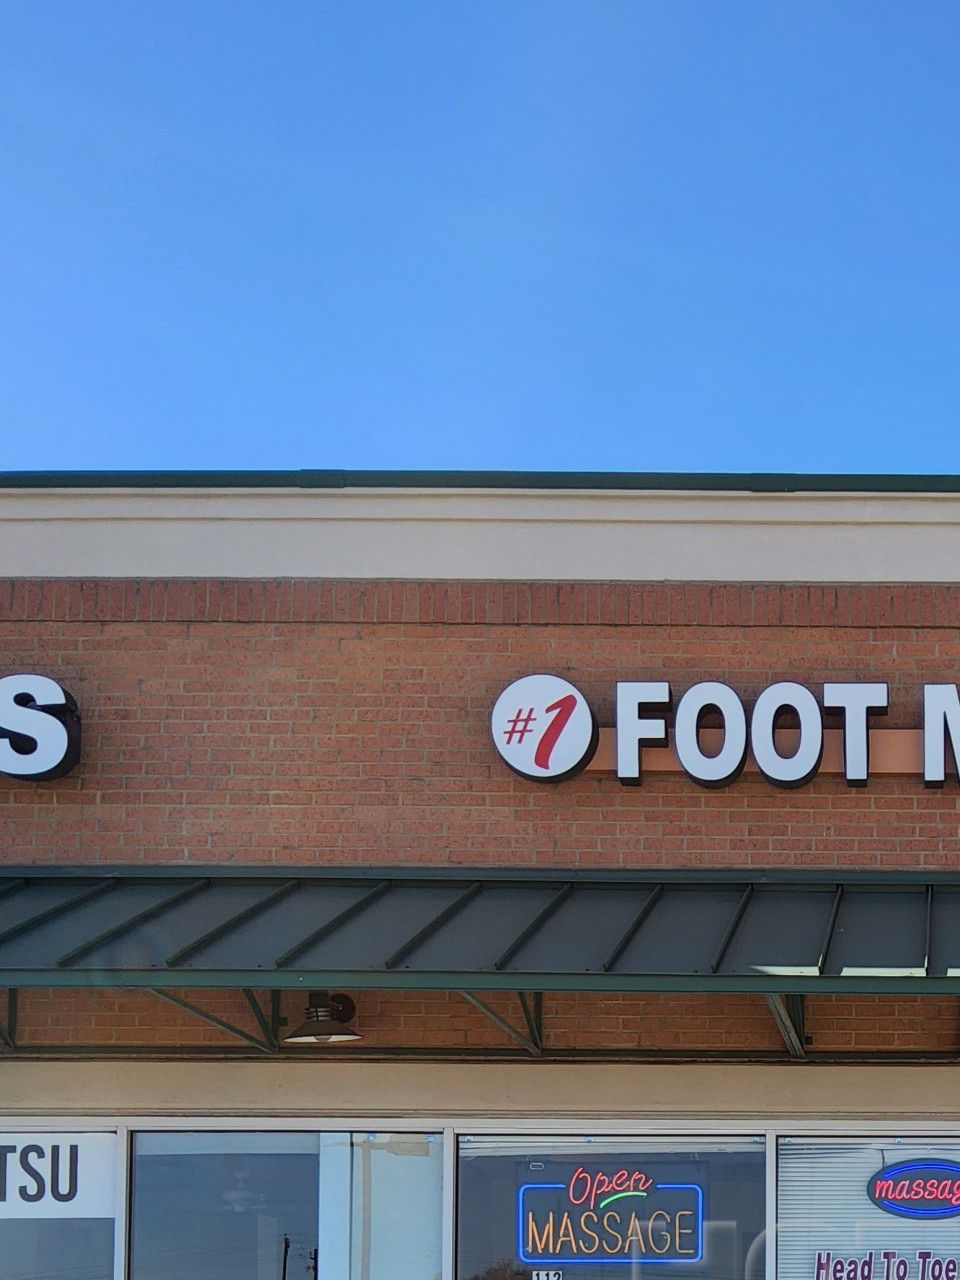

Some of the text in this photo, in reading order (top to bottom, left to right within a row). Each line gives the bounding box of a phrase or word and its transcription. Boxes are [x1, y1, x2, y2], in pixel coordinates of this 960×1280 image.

[502, 694, 578, 771] #1
[615, 681, 888, 785] FOOT
[569, 1167, 653, 1209] Open
[527, 1211, 695, 1254] MASSAGE
